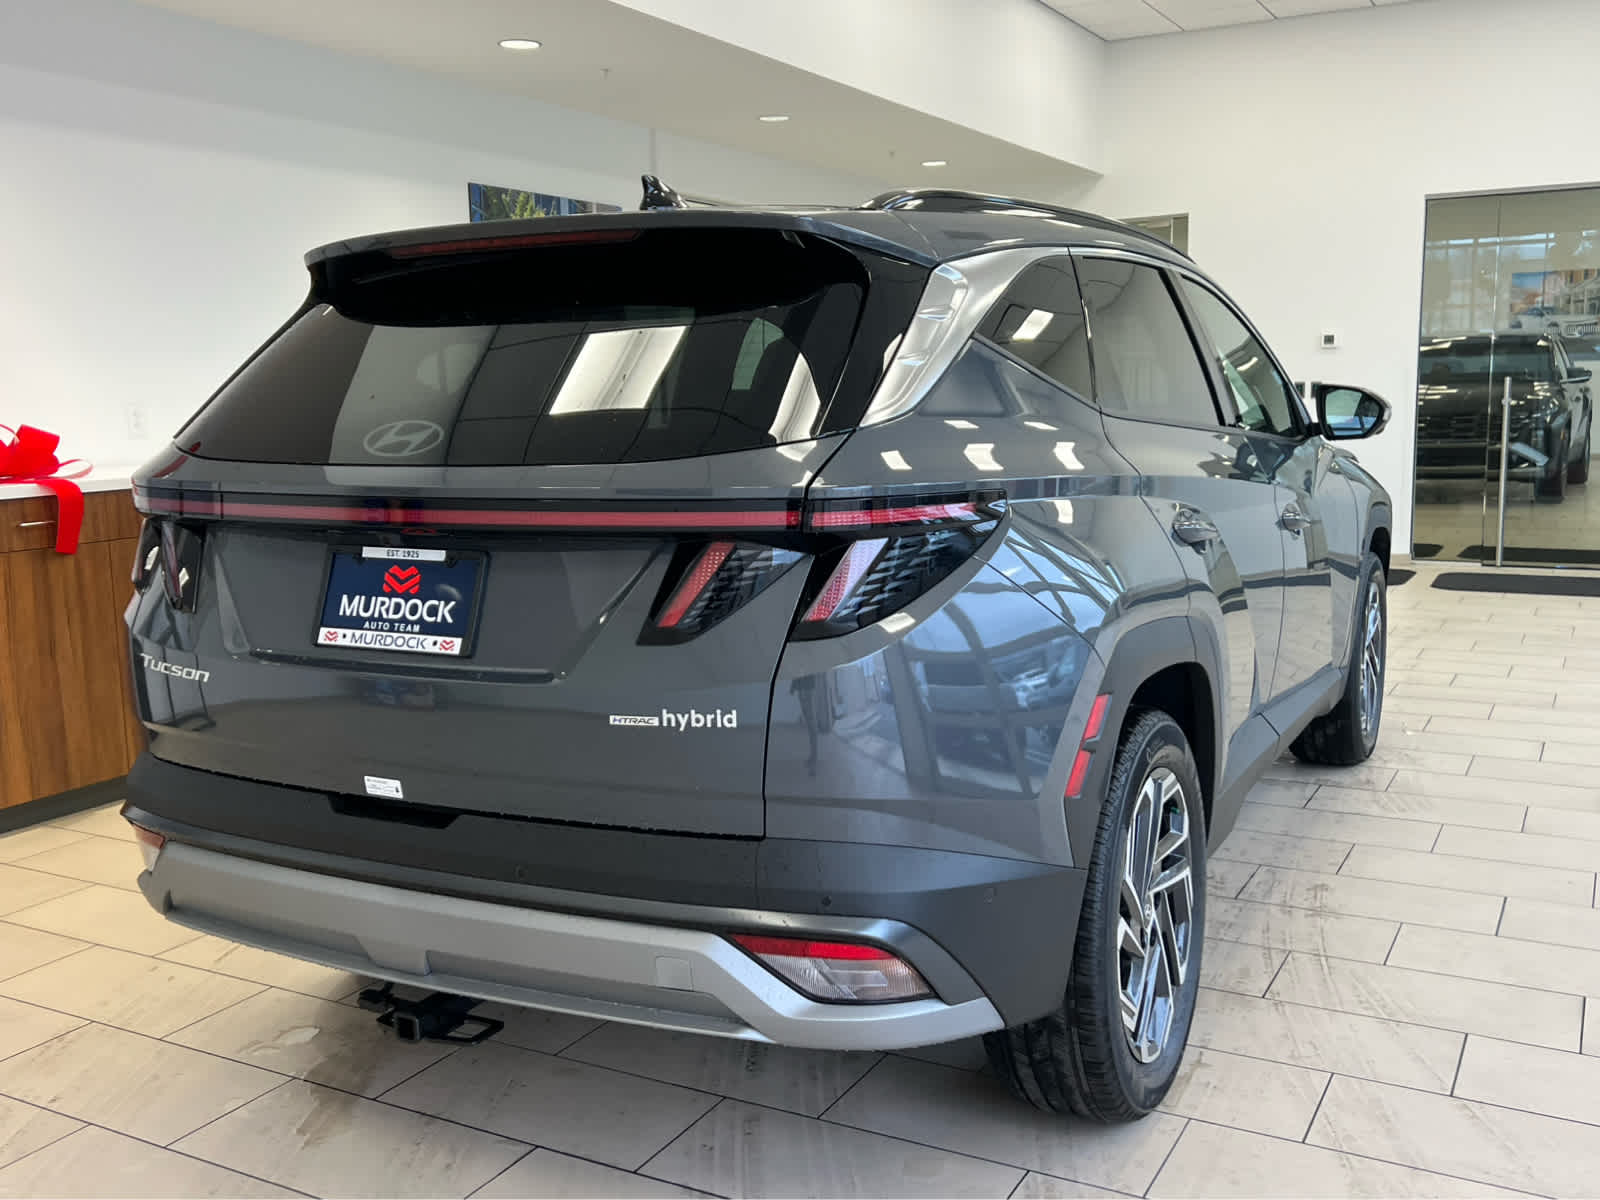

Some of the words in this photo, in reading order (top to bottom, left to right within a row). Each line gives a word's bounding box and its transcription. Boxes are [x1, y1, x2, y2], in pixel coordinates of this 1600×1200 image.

[402, 550, 420, 558] 1925
[339, 594, 456, 623] MURDOCK
[363, 621, 390, 631] AUTO
[394, 623, 420, 632] TEAM
[350, 632, 427, 650] MURDOCK
[611, 716, 657, 725] HTRAC
[662, 708, 737, 731] hybrid
